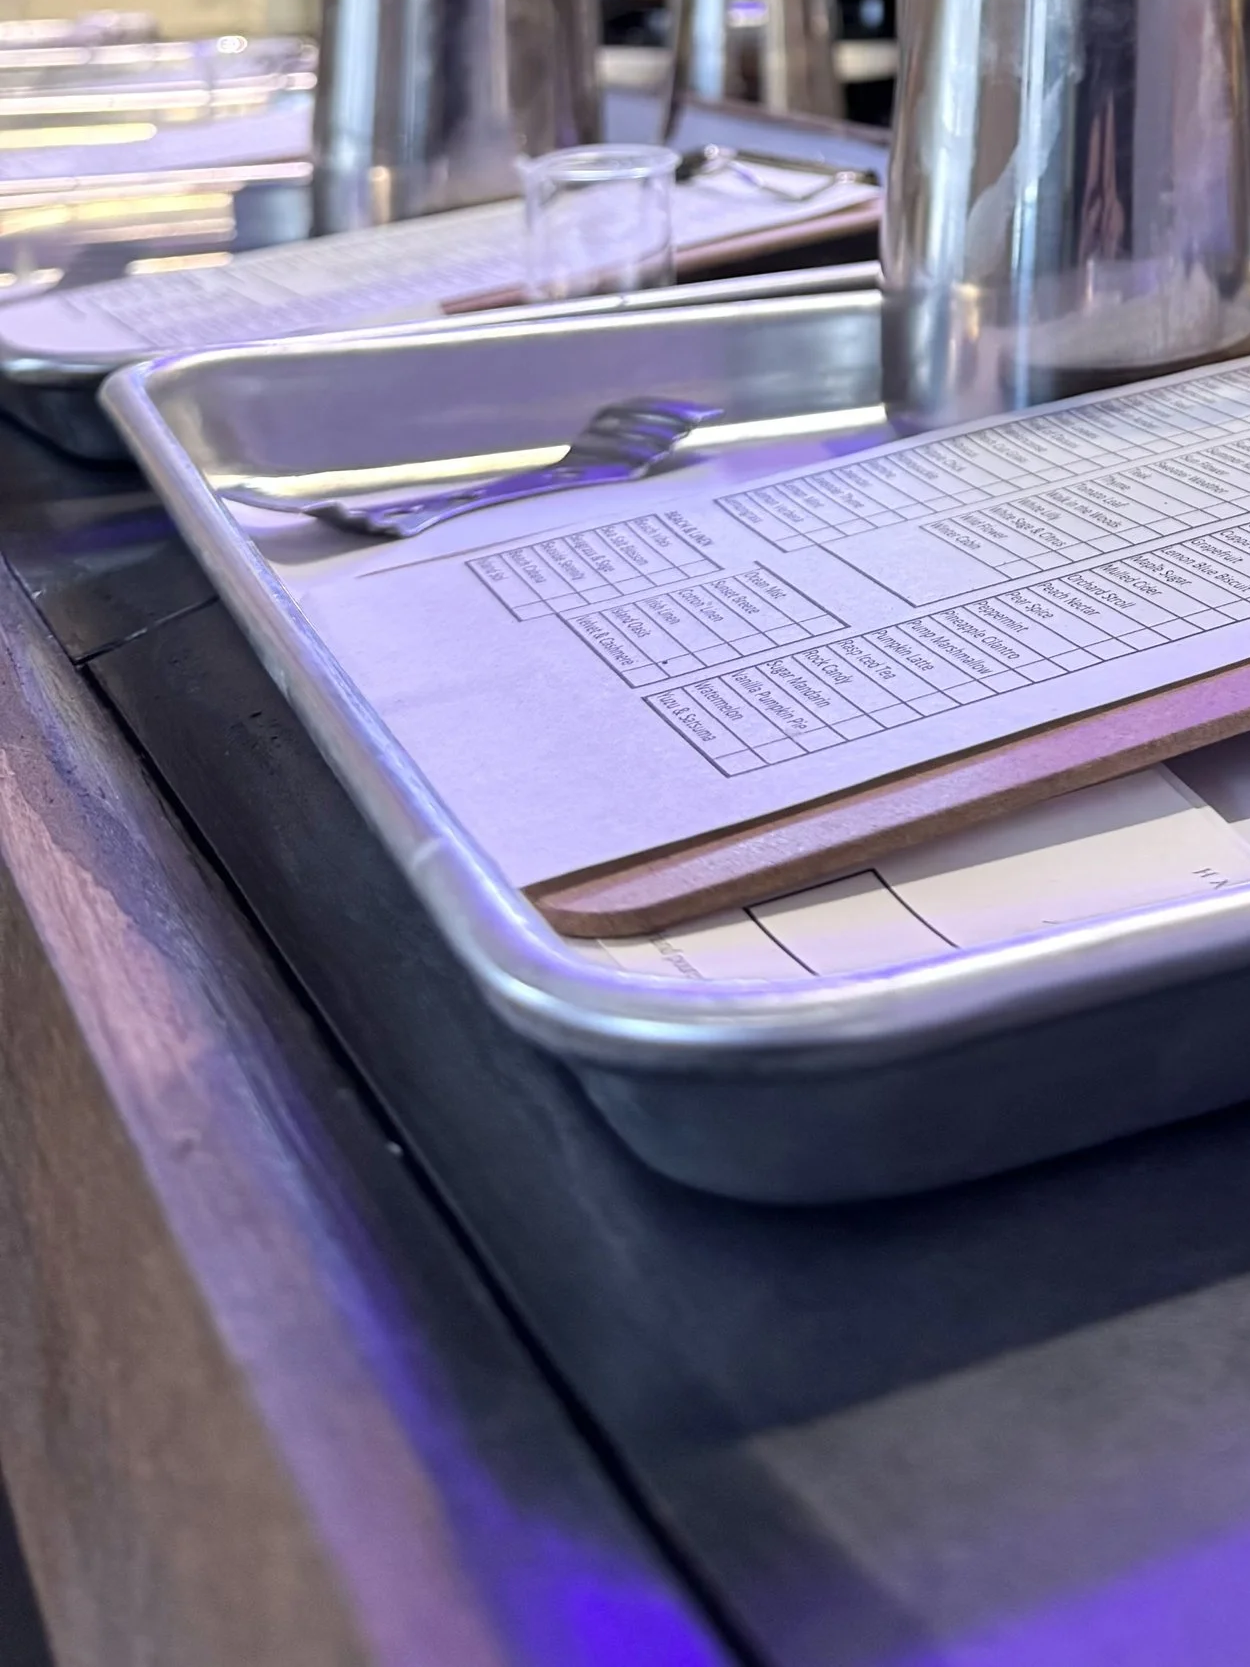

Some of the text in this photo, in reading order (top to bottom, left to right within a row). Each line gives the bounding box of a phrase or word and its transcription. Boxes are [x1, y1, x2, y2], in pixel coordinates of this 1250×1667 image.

[1160, 546, 1197, 564] Lemon
[1191, 562, 1220, 575] Blue
[1190, 538, 1247, 563] Grapefruit
[1099, 564, 1162, 596] Mulled Cider
[1130, 555, 1192, 585] Maple Sugar
[1005, 591, 1055, 618] Pear Spice
[1037, 582, 1101, 616] Peach Nectar
[1068, 573, 1139, 608] Orchard Stroll
[940, 609, 1022, 659] Pineapple Cilantro
[972, 600, 1033, 632] Peppermint
[837, 639, 898, 679] Rasp Iced Tea
[871, 629, 937, 670] Pumpkin Latte
[906, 618, 994, 674] Pump Marshmallow
[767, 659, 833, 707] Sugar Mandarin
[802, 649, 853, 685] Rock Candy
[655, 690, 682, 709] Yuzu
[679, 712, 718, 741] Satsuma
[693, 680, 745, 720] Watermelon
[730, 669, 810, 730] Vanilla Pumpkin Pie
